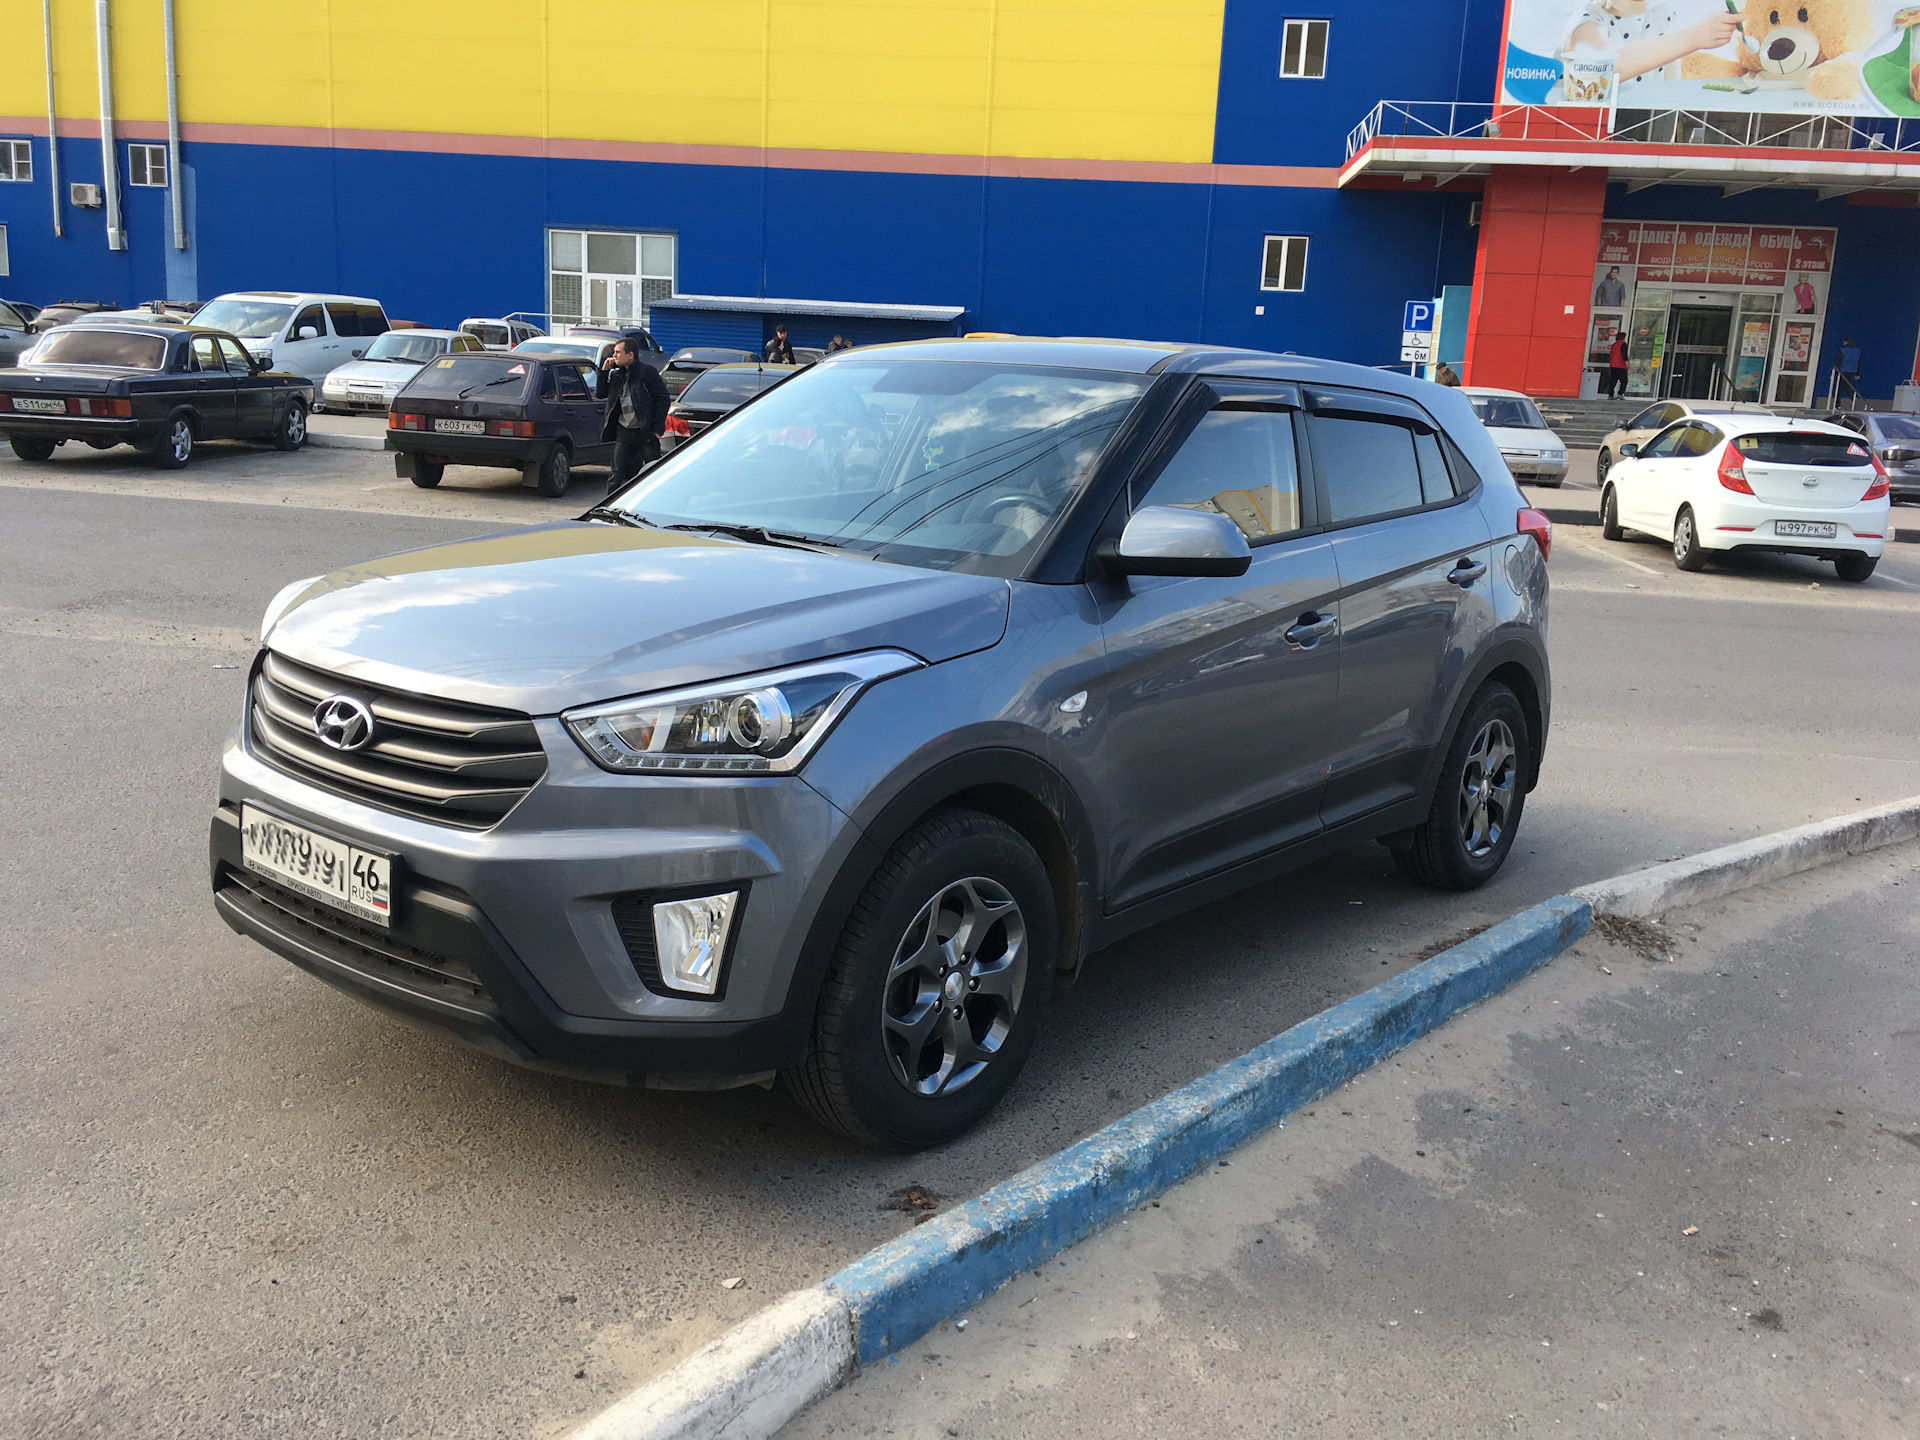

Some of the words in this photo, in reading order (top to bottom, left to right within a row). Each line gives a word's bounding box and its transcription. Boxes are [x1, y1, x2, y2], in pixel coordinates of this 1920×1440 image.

[1506, 67, 1557, 80] НОВИНКА
[1627, 229, 1687, 245] ПЛАНЕТА
[1694, 231, 1751, 249] ОДЕЖДА
[1759, 234, 1803, 249] ОБУВЬ
[1602, 253, 1622, 261] 2000
[1795, 259, 1801, 268] 2
[1411, 305, 1429, 328] P
[353, 854, 379, 892] 46
[286, 879, 306, 894] ОРИОН
[307, 887, 322, 900] АВТО
[351, 885, 372, 903] RUS
